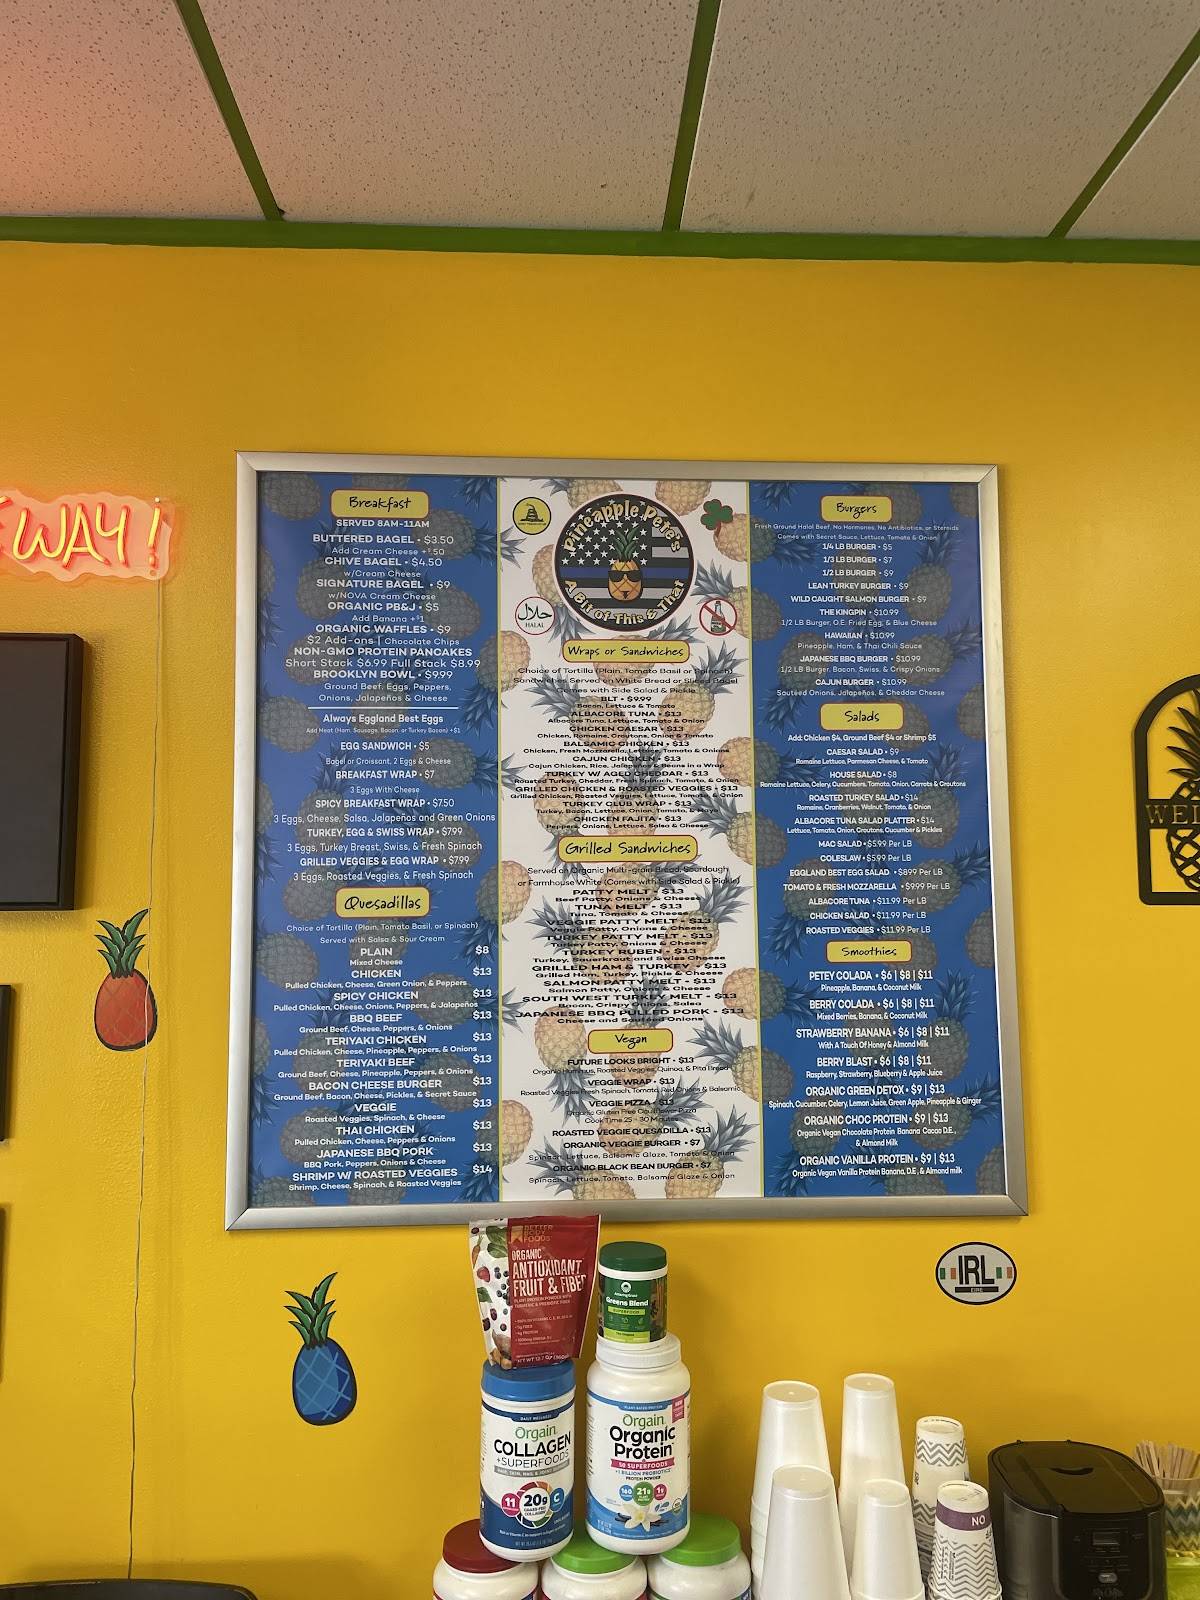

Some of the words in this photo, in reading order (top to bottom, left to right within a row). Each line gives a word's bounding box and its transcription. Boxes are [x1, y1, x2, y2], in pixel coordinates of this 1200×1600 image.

[349, 496, 412, 512] Breakfast
[836, 502, 877, 519] Burgers
[563, 500, 639, 552] Pineapple
[644, 505, 683, 552] Pete's
[313, 534, 373, 543] BUTTERED
[376, 535, 414, 544] BAGEL
[424, 535, 454, 545] $3.50
[325, 557, 361, 566] CHIVE
[364, 557, 402, 566] BAGEL
[411, 558, 442, 567] $4.50
[316, 579, 383, 588] SIGNATURE
[386, 580, 424, 589] BAGEL
[436, 580, 450, 590] $9
[829, 582, 859, 590] TURKEY
[861, 582, 891, 590] BURGER
[898, 582, 909, 590] $9
[328, 602, 383, 611] ORGANIC
[386, 603, 416, 611] PB&J
[425, 602, 439, 612] $5
[565, 580, 577, 593] A
[573, 592, 594, 613] Bit
[614, 612, 644, 625] This
[646, 608, 657, 620] &
[657, 579, 684, 612] That
[294, 648, 354, 656] NON-GMO
[358, 648, 407, 656] PROTEIN
[410, 648, 472, 657] PANCAKES
[568, 646, 600, 659] Wraps
[621, 646, 684, 657] Sandwiches
[285, 658, 316, 667] Short
[320, 658, 353, 668] Stack
[357, 658, 387, 668] $6.99
[391, 659, 411, 668] Full
[414, 659, 446, 668] Stack
[450, 659, 481, 668] $8.99
[313, 670, 377, 679] BROOKLYN
[380, 670, 415, 679] BOWL
[815, 678, 842, 686] CAJUN
[843, 678, 874, 686] BURGER
[323, 714, 356, 725] Always
[359, 714, 396, 725] Eggland
[398, 714, 420, 723] Best
[422, 714, 443, 725] Eggs
[844, 710, 880, 723] Salads
[340, 742, 360, 751] EGG
[362, 742, 412, 750] SANDWICH
[419, 741, 430, 751] $5
[827, 748, 856, 756] CAESAR
[858, 748, 883, 756] SALAD
[889, 748, 899, 756] $9
[336, 771, 388, 779] BREAKFAST
[390, 770, 417, 779] WRAP
[424, 770, 434, 779] $7
[830, 771, 856, 779] HOUSE
[888, 771, 897, 779] $8
[565, 842, 612, 856] Grilled
[618, 842, 691, 855] Sandwiches
[820, 854, 861, 862] COLESLAW
[344, 896, 421, 911] Quesadillas
[810, 912, 843, 920] CHICKEN
[360, 947, 392, 956] PLAIN
[475, 946, 489, 955] $8
[841, 946, 897, 958] Smoothies
[351, 969, 401, 978] CHICKEN
[473, 967, 492, 976] $13
[809, 972, 836, 981] PETEY
[836, 971, 872, 980] COLADA
[881, 970, 892, 980] $6
[809, 1000, 837, 1009] BERRY
[838, 1000, 874, 1009] COLADA
[883, 999, 894, 1009] $6
[796, 1029, 854, 1038] STRAWBERRY
[855, 1028, 892, 1037] BANANA
[325, 1036, 374, 1045] TERIYAKI
[377, 1035, 427, 1044] CHICKEN
[614, 1034, 647, 1049] Vegan
[567, 1058, 602, 1066] FUTURE
[678, 1056, 694, 1064] $13
[309, 1082, 348, 1091] BACON
[351, 1081, 394, 1090] CHEESE
[397, 1080, 442, 1089] BURGER
[806, 1086, 845, 1096] ORGANIC
[846, 1086, 875, 1095] GREEN
[876, 1085, 904, 1095] DETOX
[354, 1104, 397, 1112] VEGGIE
[804, 1116, 844, 1126] ORGANIC
[845, 1115, 871, 1124] CHOC
[872, 1114, 908, 1124] PROTEIN
[552, 1129, 594, 1137] ROASTED
[608, 1140, 642, 1148] VEGGIE
[690, 1139, 700, 1147] $7
[317, 1148, 374, 1158] JAPANESE
[376, 1148, 400, 1157] BBQ
[403, 1147, 434, 1156] PORK
[293, 1172, 337, 1182] SHRIMP
[354, 1170, 406, 1179] ROASTED
[409, 1169, 458, 1178] VEGGIES
[473, 1165, 492, 1175] $14
[512, 1249, 542, 1261] ORGANIC
[513, 1259, 582, 1279] ANTIOXIDANT
[958, 1255, 994, 1284] IRL
[514, 1278, 544, 1297] FRUIT
[549, 1279, 558, 1294] &
[606, 1297, 628, 1306] Greens
[623, 1414, 664, 1430] Orgain
[515, 1425, 556, 1442] Orgain
[610, 1426, 676, 1446] Organic
[494, 1431, 571, 1457] COLLAGEN
[614, 1443, 672, 1459] Protein
[627, 1462, 668, 1470] SUPERFOODS
[505, 1498, 516, 1508] 11
[524, 1494, 548, 1507] 20g
[972, 1515, 986, 1526] NO
